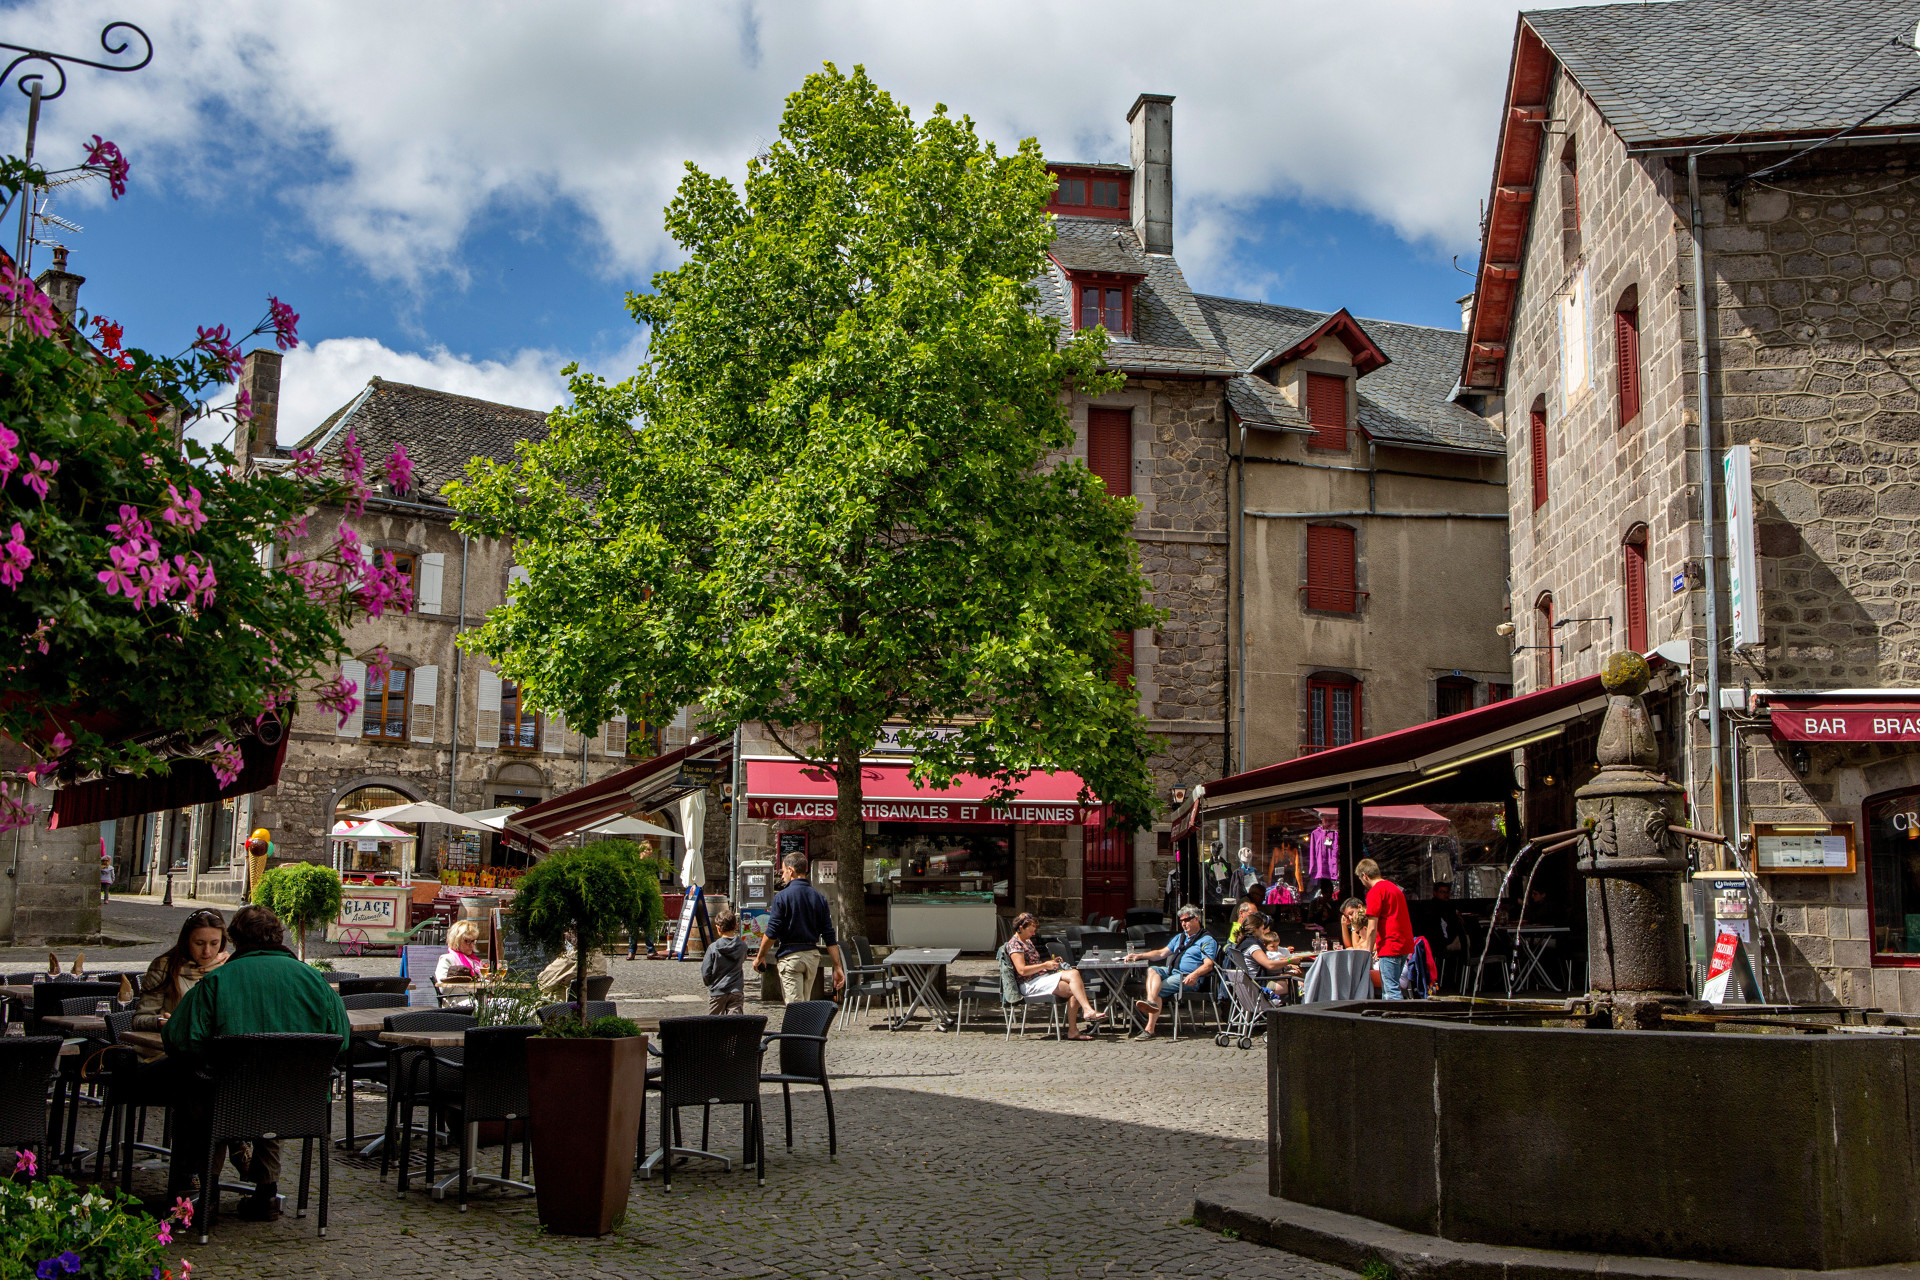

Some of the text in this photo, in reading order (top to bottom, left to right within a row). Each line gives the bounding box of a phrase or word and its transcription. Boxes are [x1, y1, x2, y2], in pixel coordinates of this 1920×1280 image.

[1805, 718, 1920, 734] BAR BRA
[772, 801, 1075, 821] GLACES RTISANALES ET ITALIENNES
[344, 900, 391, 917] GLACE
